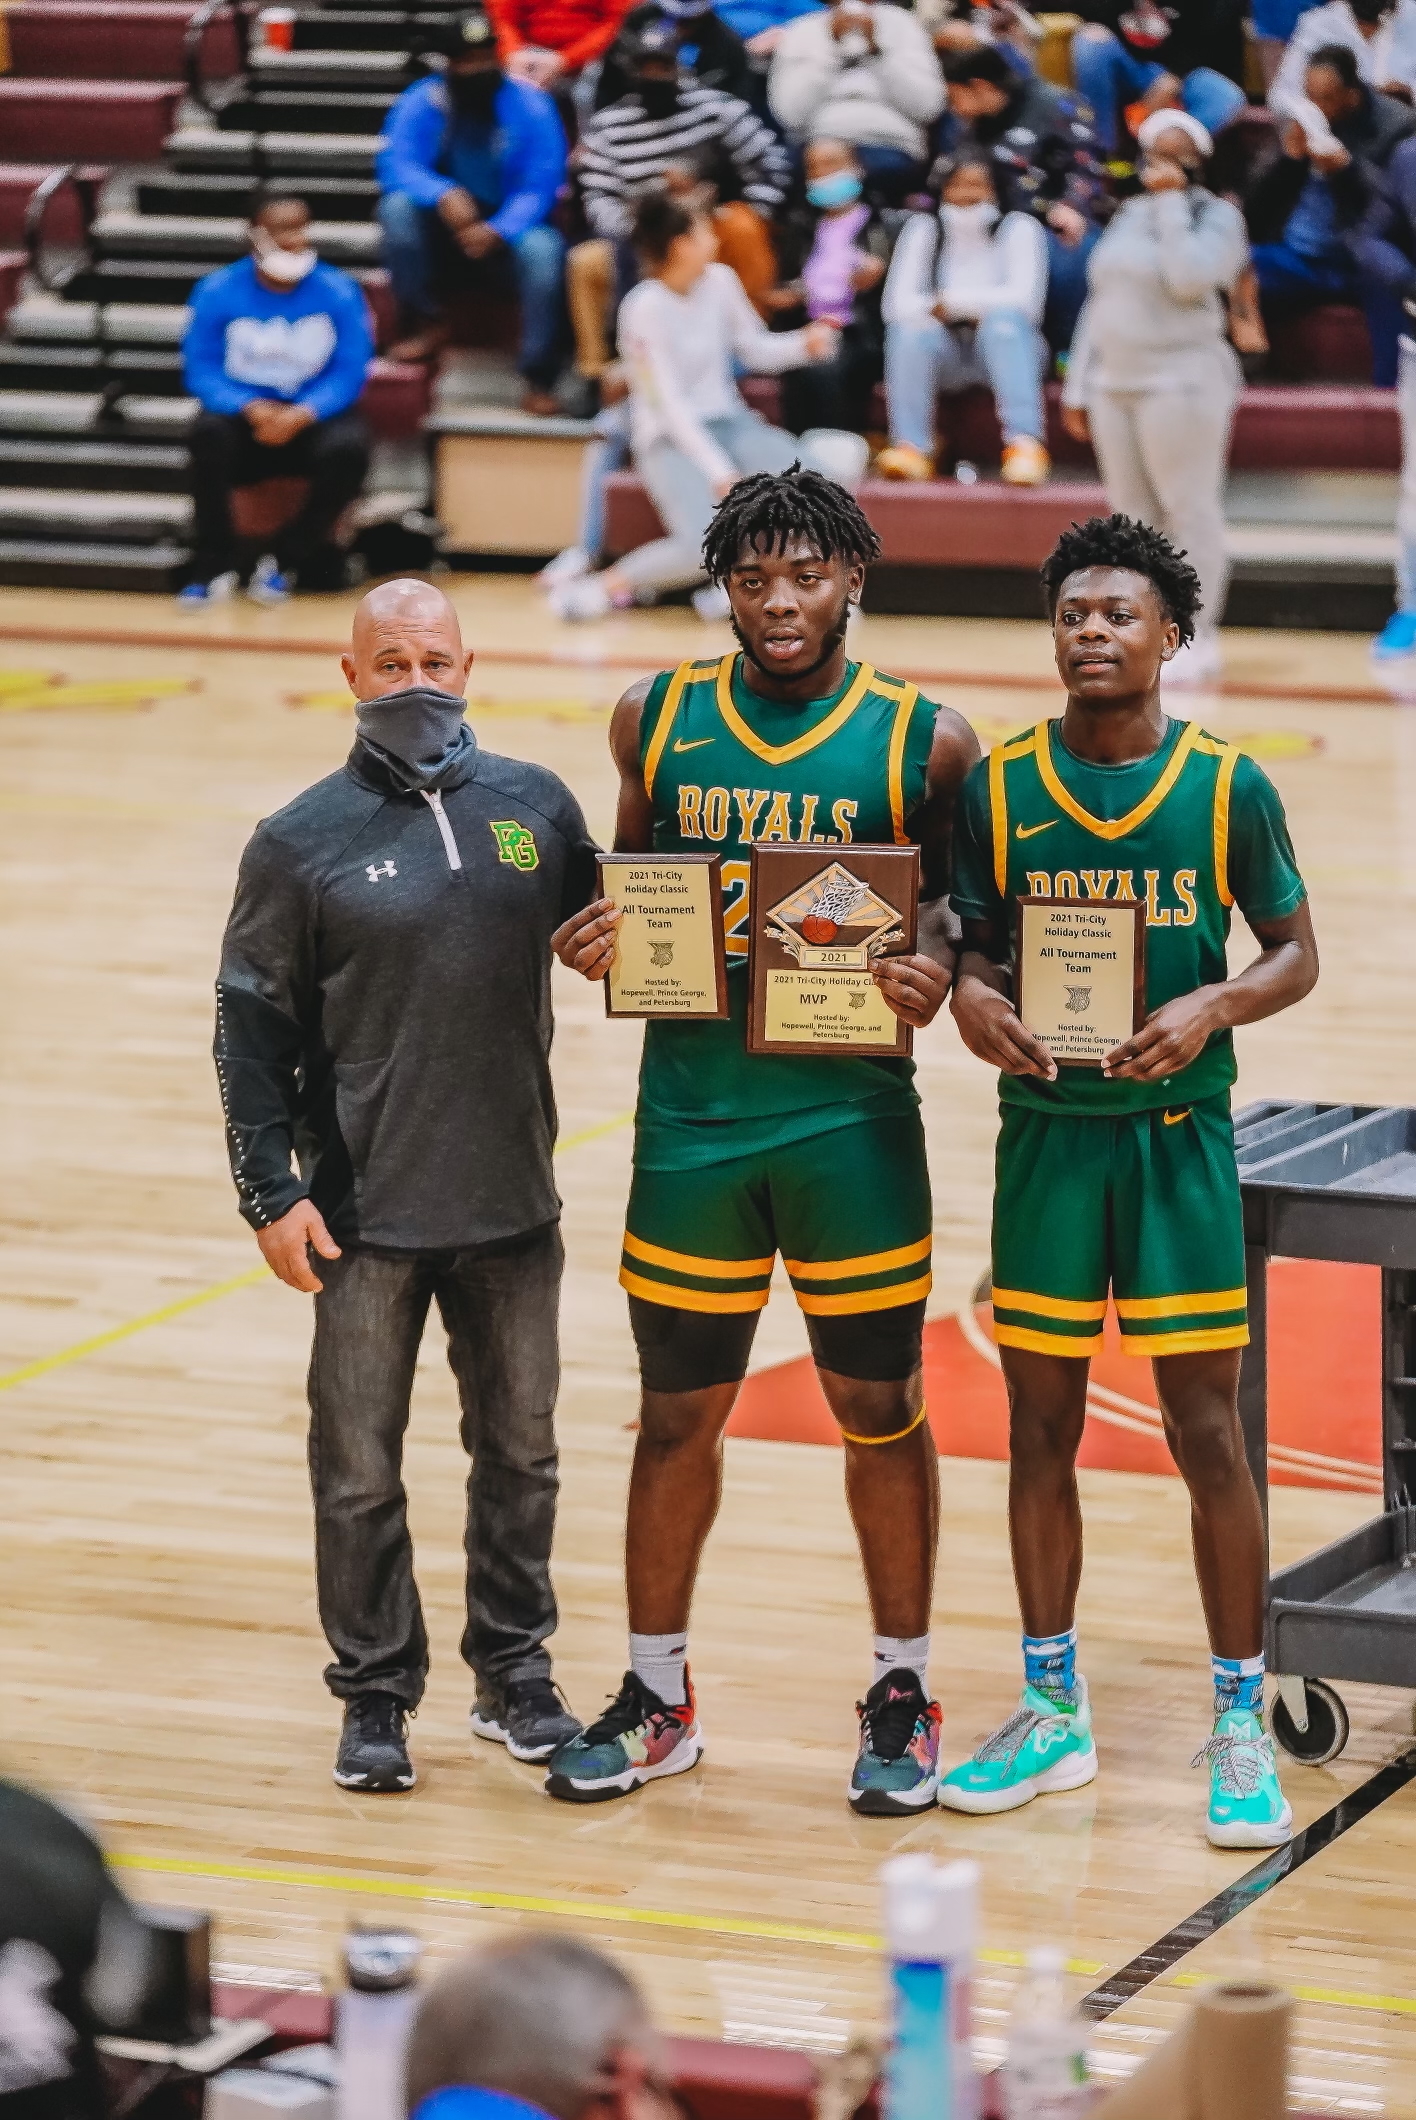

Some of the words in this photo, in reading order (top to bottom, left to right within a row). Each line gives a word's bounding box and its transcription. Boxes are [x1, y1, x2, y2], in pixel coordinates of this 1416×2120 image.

[677, 784, 859, 843] ROYALS
[488, 819, 539, 871] PG
[629, 871, 649, 880] 2021
[652, 871, 683, 881] Tri-City
[625, 885, 657, 895] Holiday
[660, 885, 689, 894] Classic
[622, 905, 635, 914] All
[638, 905, 695, 914] Tournament
[647, 919, 672, 928] Team
[1050, 913, 1071, 923] 2021
[1075, 914, 1107, 926] Tri-City
[1045, 927, 1079, 939] Holiday
[1081, 929, 1112, 938] Classic
[821, 952, 847, 962] 2021
[1039, 947, 1054, 958] All
[1057, 948, 1117, 960] Tournament
[1065, 963, 1091, 973] Team
[670, 979, 682, 987] by:
[774, 975, 794, 984] 2021
[797, 977, 827, 986] Tri-City
[829, 977, 861, 987] Holiday
[657, 989, 678, 997] Prince
[680, 990, 707, 998] George,
[653, 999, 691, 1007] Petersburg
[800, 994, 828, 1005] MVP
[840, 1015, 850, 1023] by:
[781, 1022, 816, 1030] Hopewell,
[840, 1024, 867, 1032] George,
[1058, 1024, 1083, 1032] Hosted
[1085, 1024, 1096, 1033] by:
[813, 1031, 850, 1039] Petersburg
[1070, 1035, 1092, 1043] Prince
[1094, 1036, 1122, 1046] George,
[1065, 1045, 1104, 1055] Petersburg
